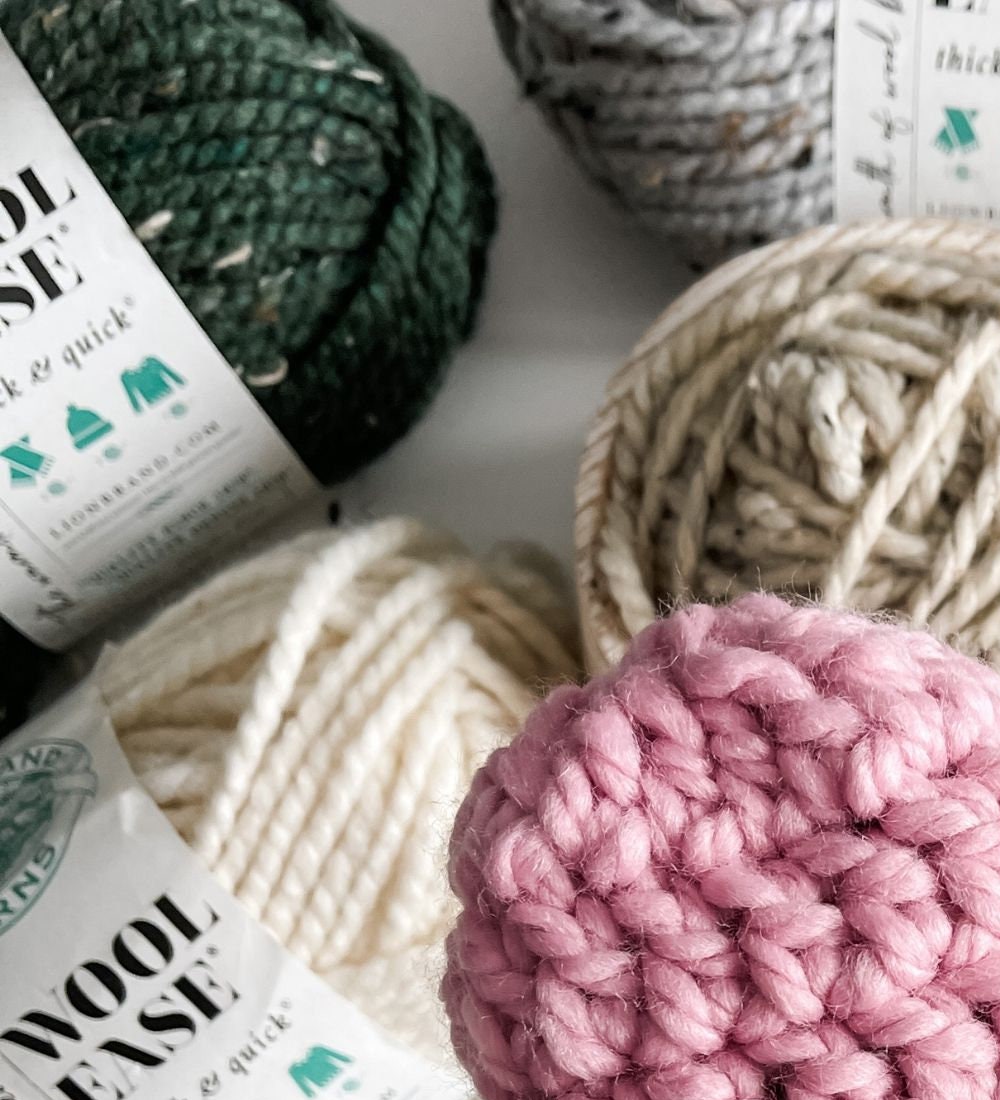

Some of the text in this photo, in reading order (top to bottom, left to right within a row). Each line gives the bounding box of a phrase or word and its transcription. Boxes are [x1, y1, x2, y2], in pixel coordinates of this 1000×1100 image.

[31, 354, 52, 387] &
[0, 893, 221, 1061] WOOL
[200, 1071, 221, 1099] &
